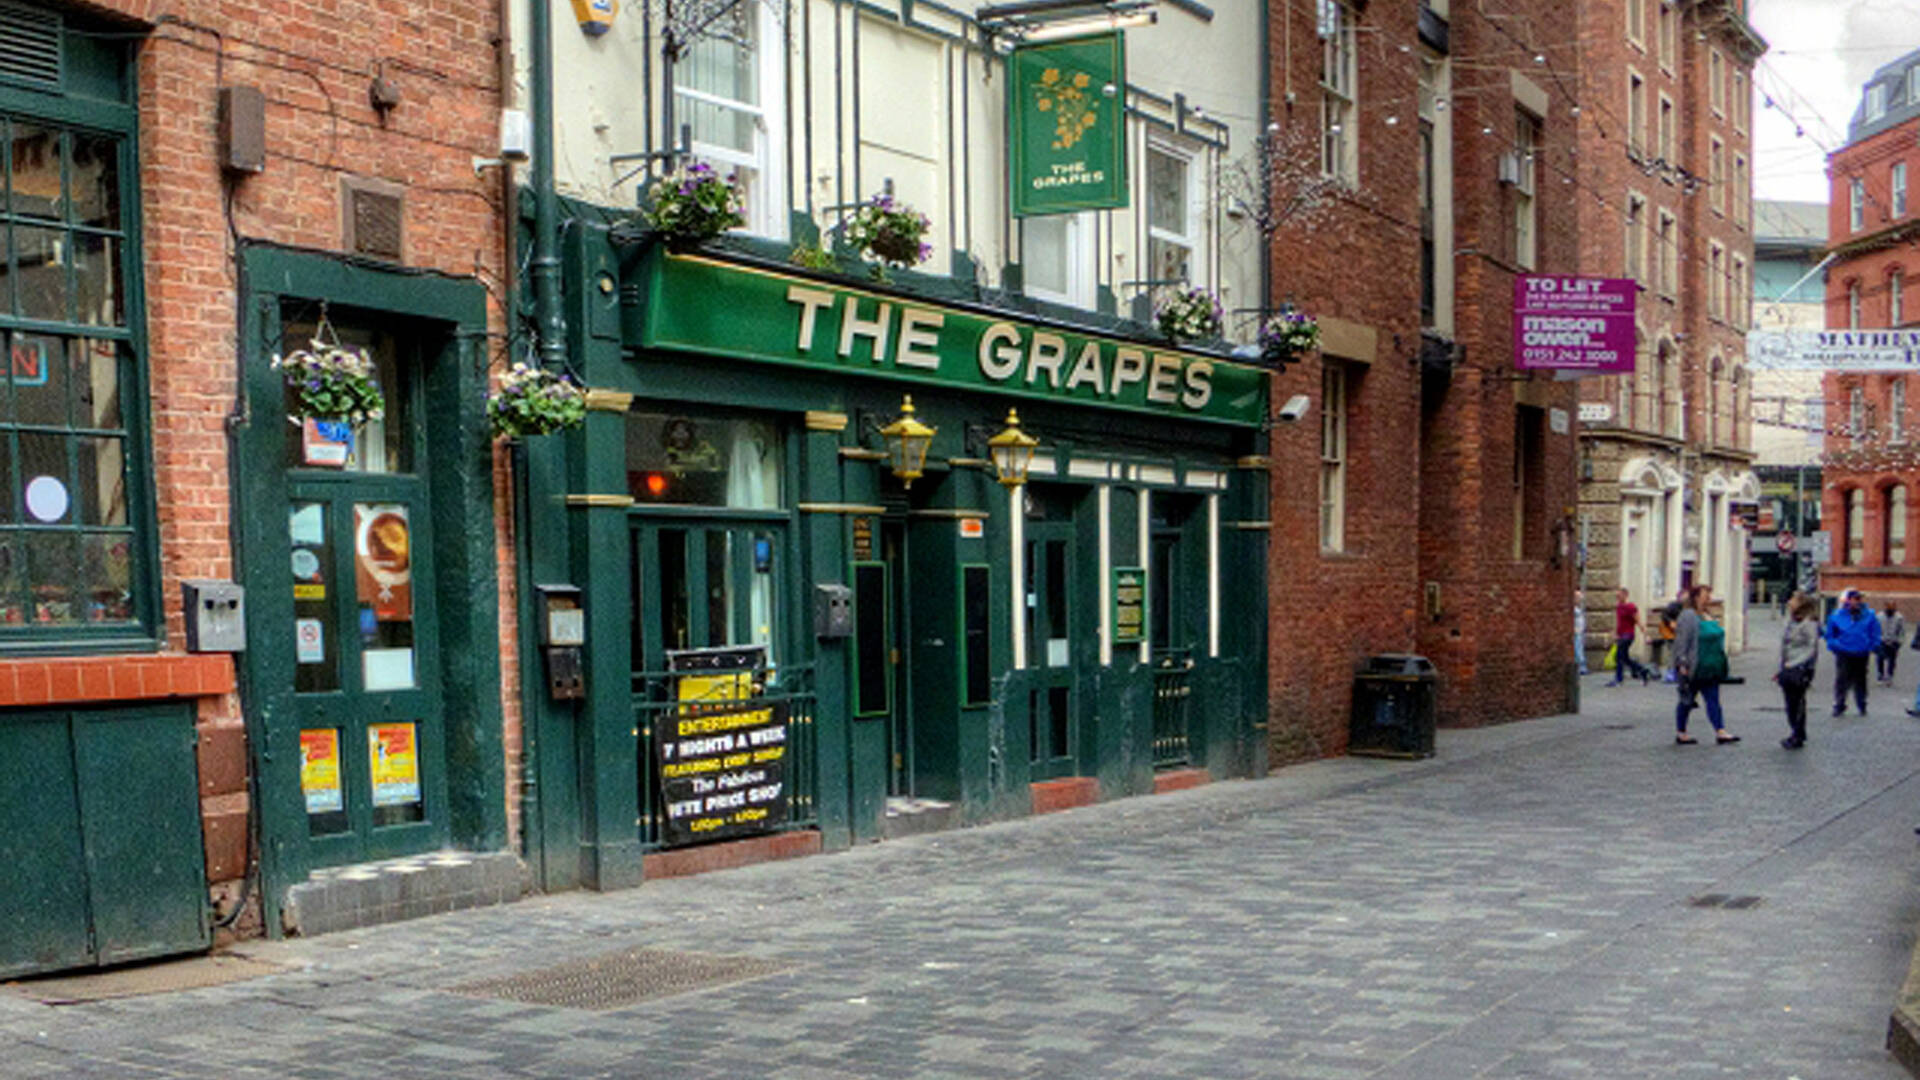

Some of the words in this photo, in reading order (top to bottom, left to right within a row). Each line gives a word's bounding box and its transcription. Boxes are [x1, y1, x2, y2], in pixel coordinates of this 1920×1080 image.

[1051, 162, 1085, 175] THE
[1033, 170, 1104, 189] GRAPES
[1526, 278, 1557, 292] TO
[1562, 279, 1603, 292] LET
[1523, 316, 1606, 333] mason
[787, 285, 946, 370] THE
[978, 321, 1216, 409] GRAPES
[663, 743, 674, 758] 7
[679, 735, 733, 757] NIGHTS
[736, 734, 748, 748] A
[750, 726, 785, 746] WEEK
[692, 779, 715, 793] The
